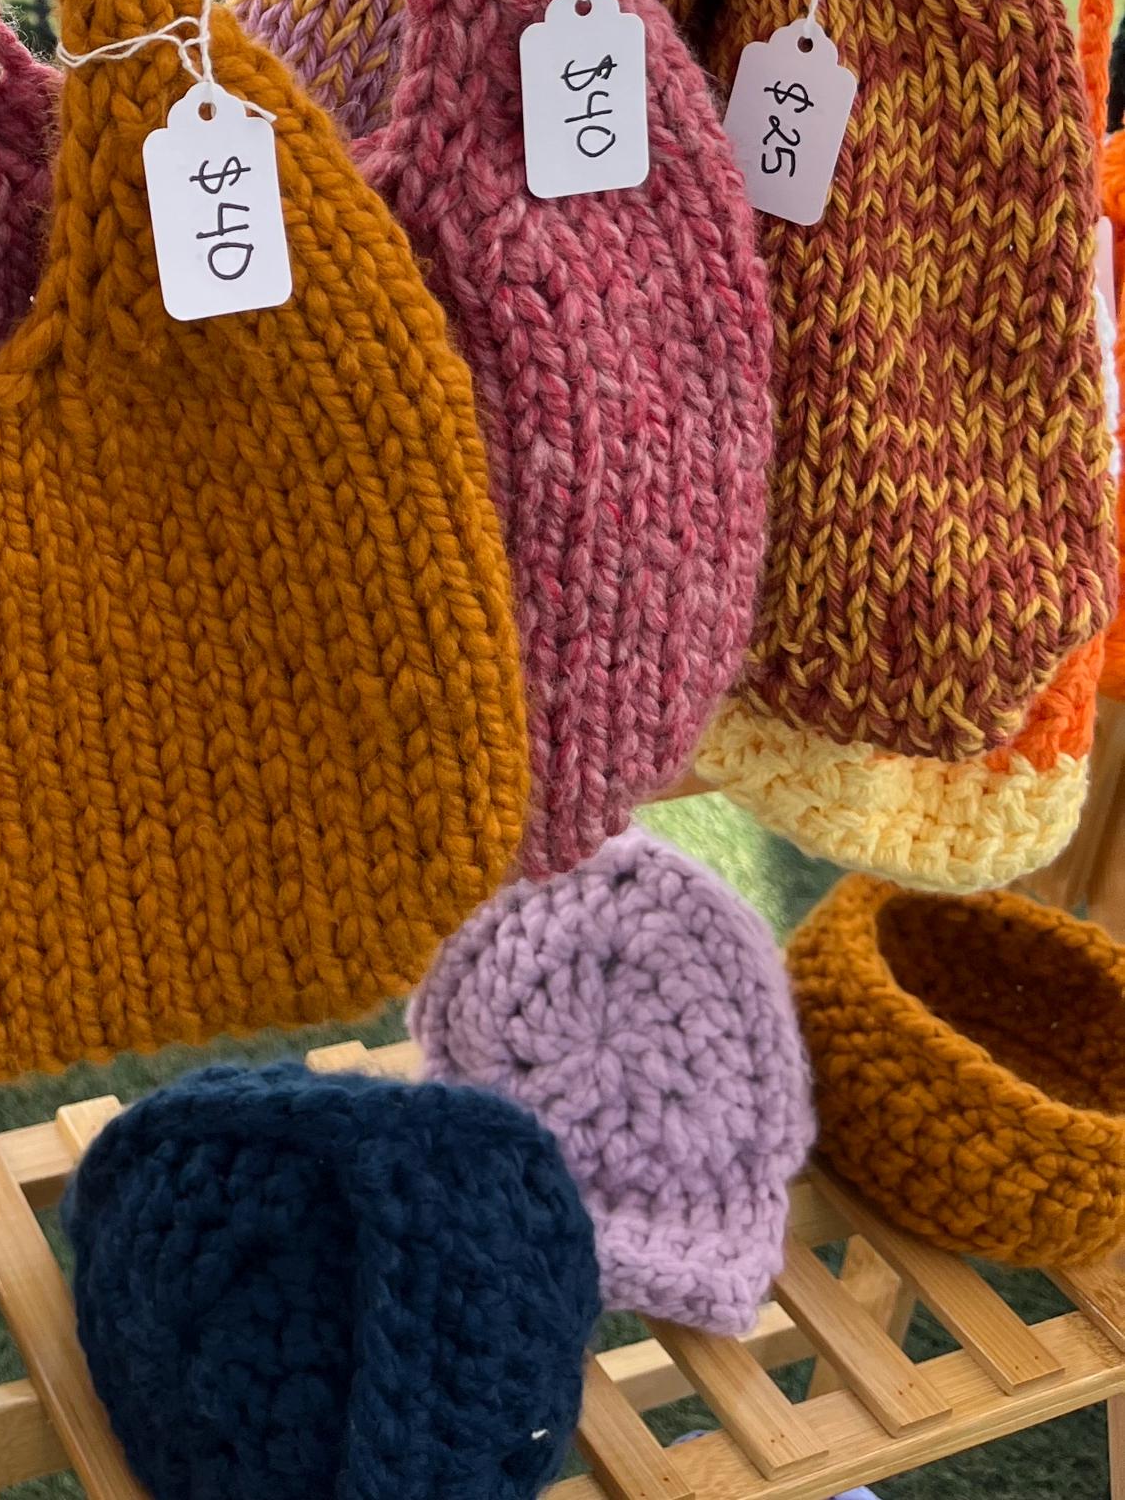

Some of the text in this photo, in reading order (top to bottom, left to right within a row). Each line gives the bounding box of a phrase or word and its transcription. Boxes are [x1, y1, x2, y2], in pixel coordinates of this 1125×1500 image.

[560, 54, 617, 158] $40
[760, 80, 815, 178] $25
[189, 155, 255, 281] $40
